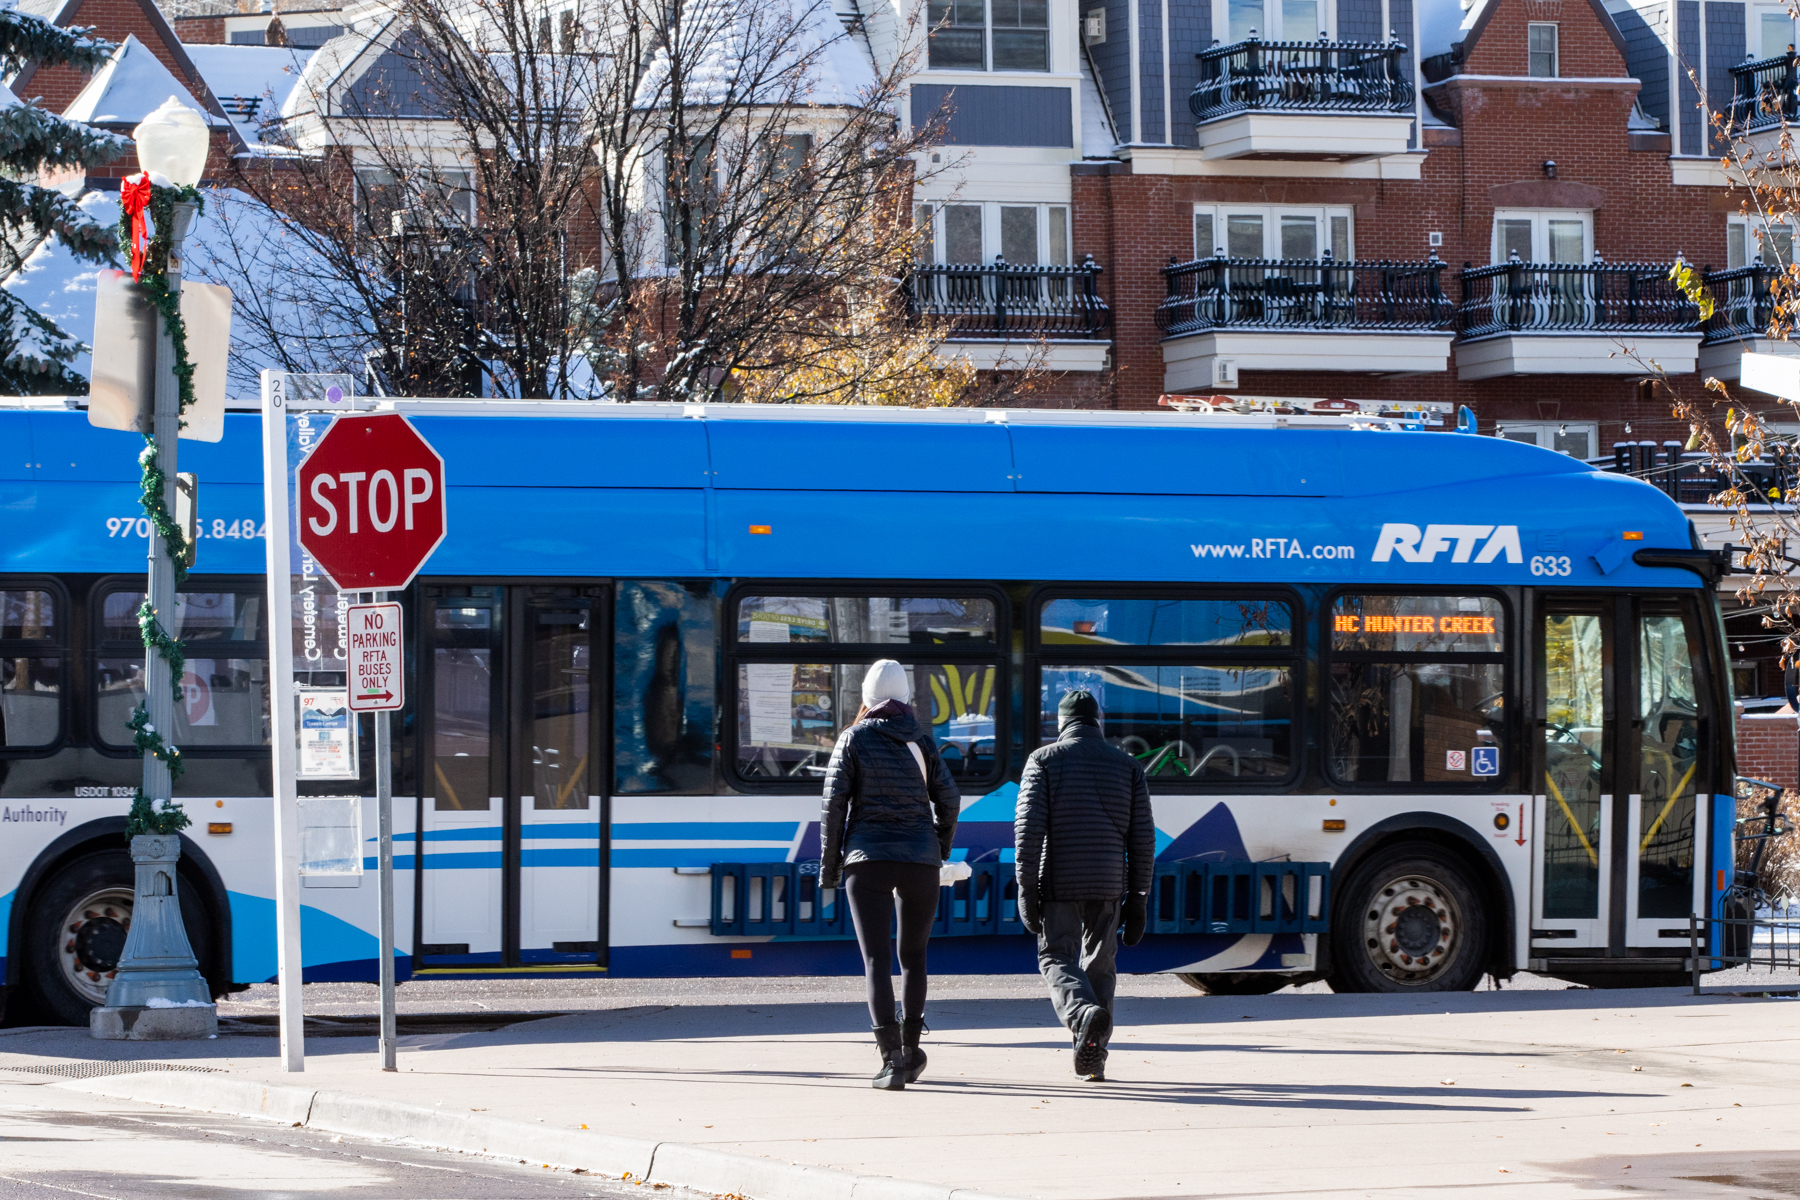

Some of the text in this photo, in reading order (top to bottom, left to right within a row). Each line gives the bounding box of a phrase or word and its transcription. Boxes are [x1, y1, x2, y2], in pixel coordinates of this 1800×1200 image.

[308, 467, 434, 537] STOP
[1190, 538, 1355, 559] www.RFTA.com
[1371, 523, 1523, 564] RFTA
[1530, 555, 1572, 577] 633
[333, 591, 348, 661] Cemeter
[364, 613, 384, 630] NO
[1334, 615, 1495, 633] HC HUNTER CREEK
[352, 631, 397, 649] PARKING
[363, 650, 387, 662] RFTA
[358, 662, 392, 676] BUSES
[362, 675, 389, 689] ONLY
[303, 697, 315, 706] 97
[74, 786, 110, 797] USDOT
[2, 804, 68, 826] Authority
